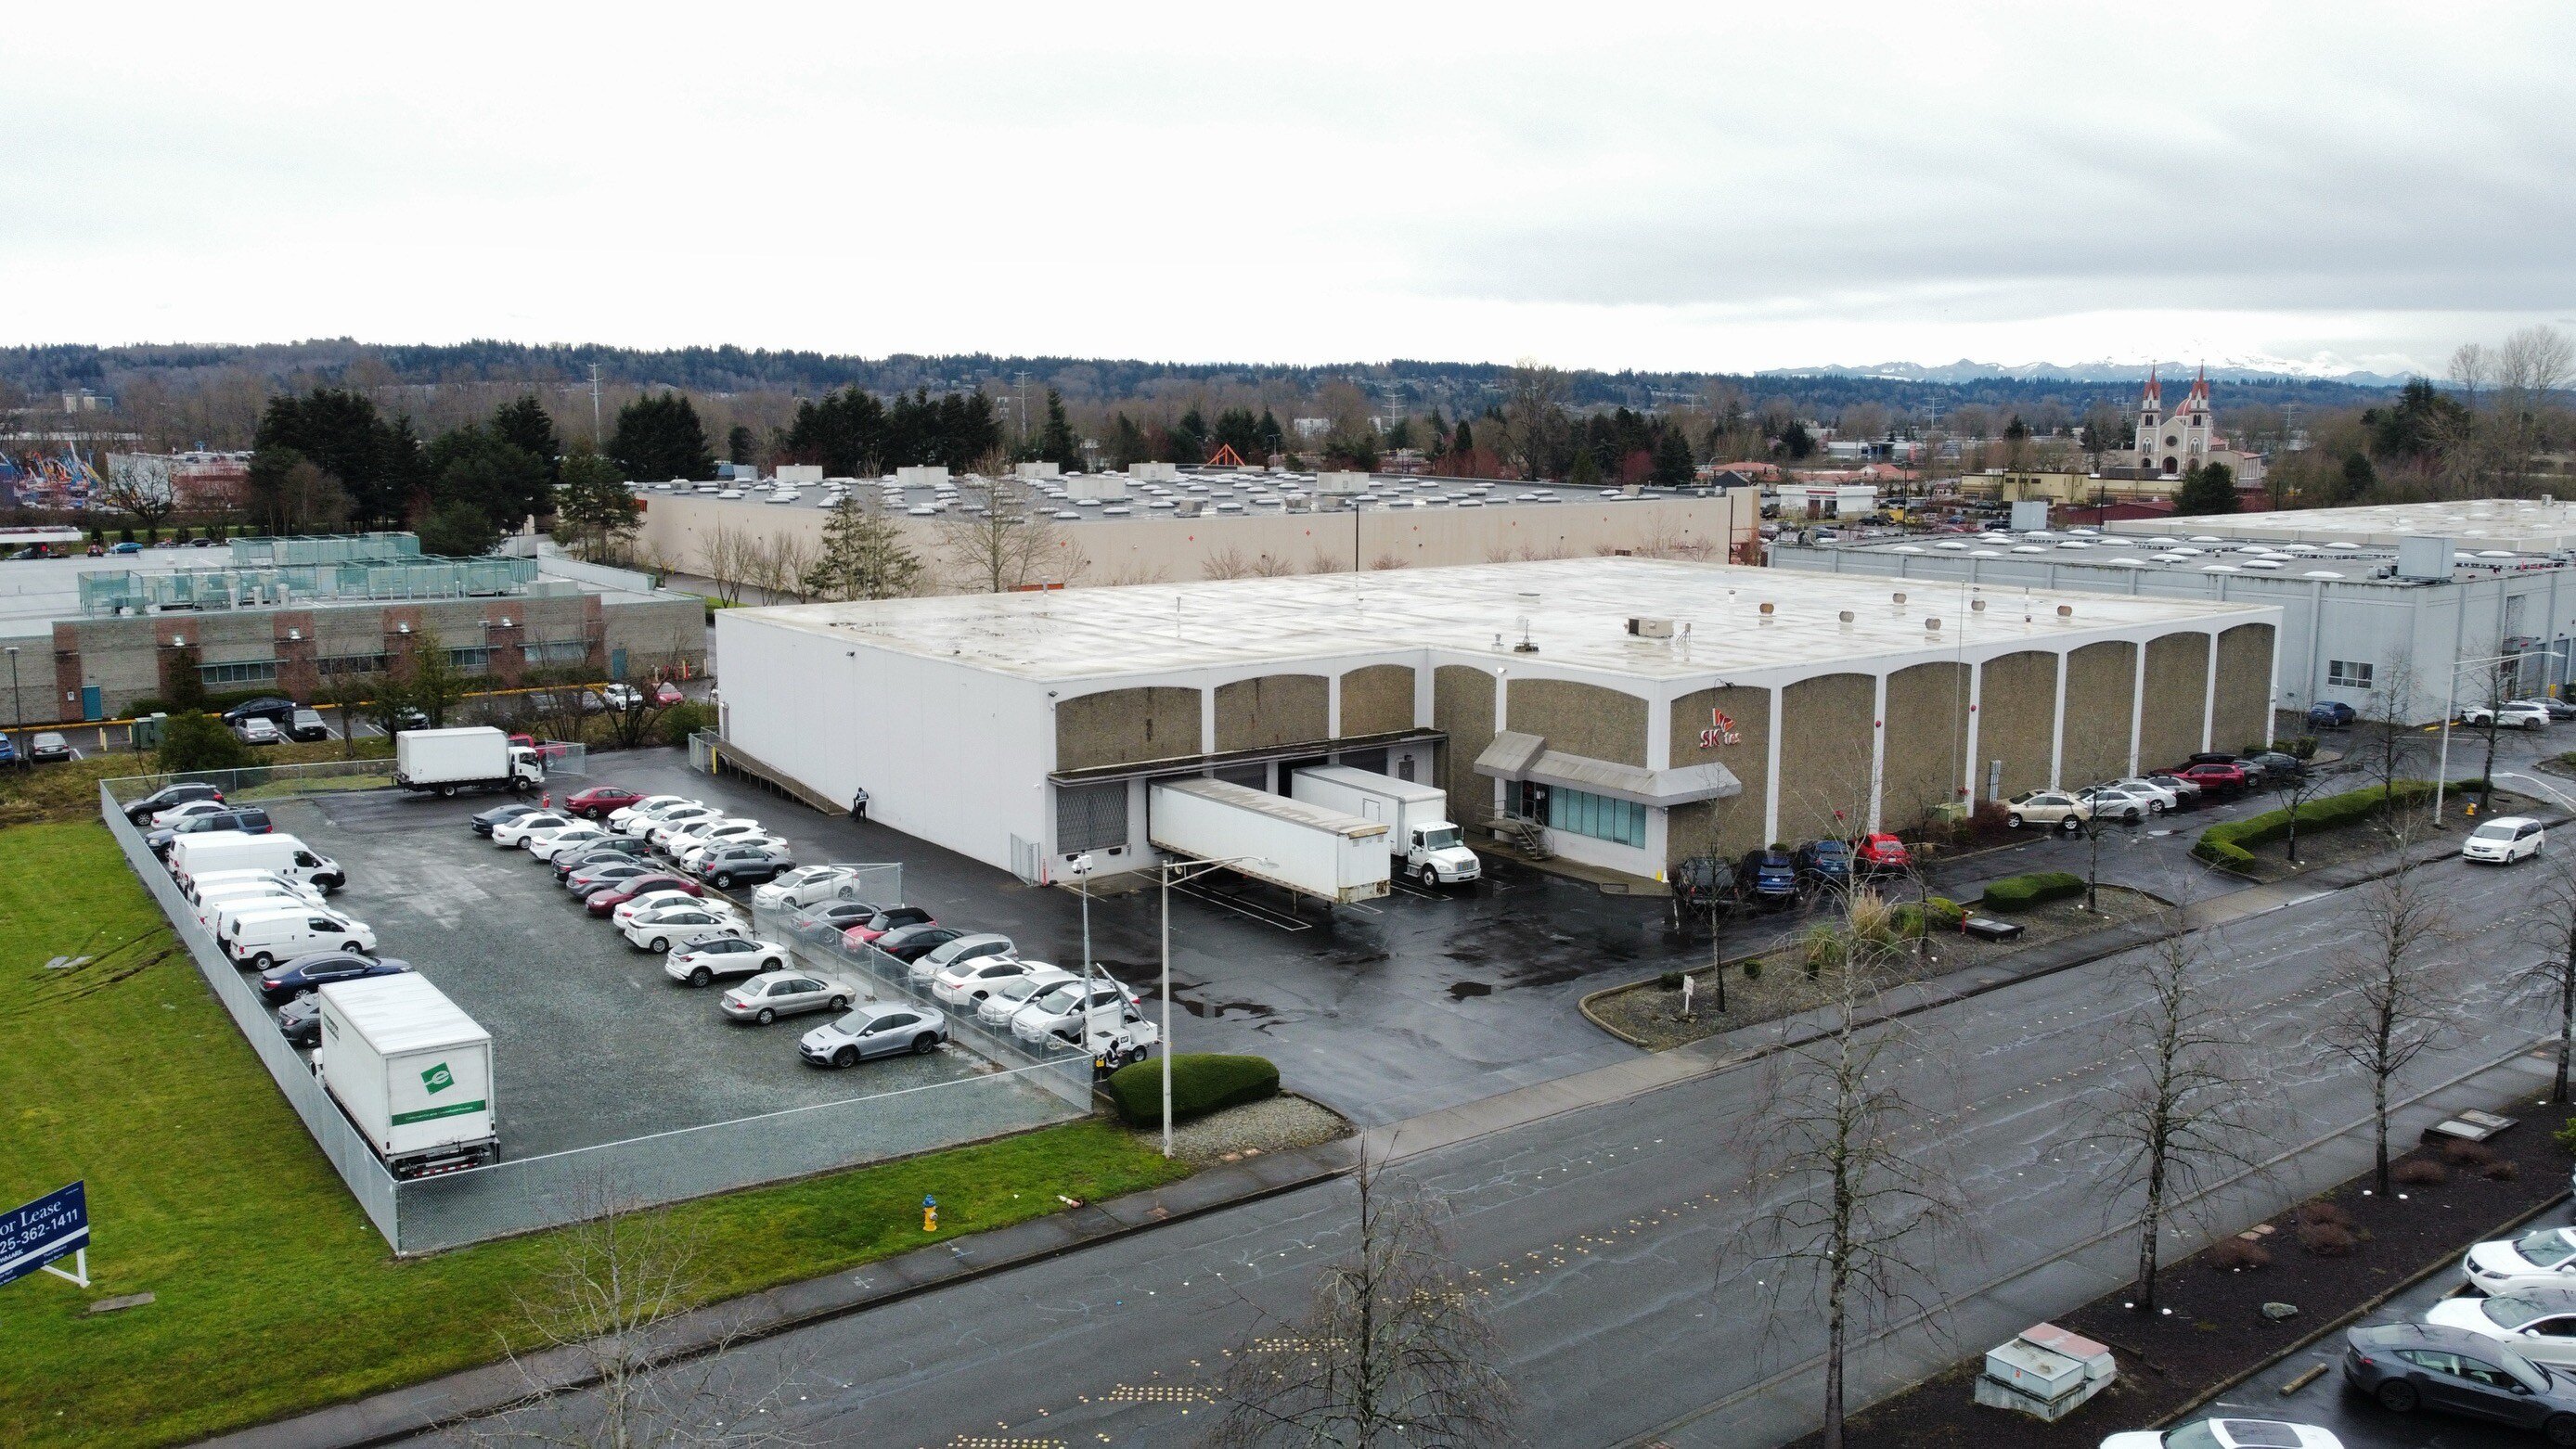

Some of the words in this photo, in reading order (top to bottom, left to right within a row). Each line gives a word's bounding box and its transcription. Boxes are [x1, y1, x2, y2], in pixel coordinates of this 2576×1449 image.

[1699, 728, 1720, 749] SK
[19, 1200, 62, 1228] Lease
[0, 1208, 78, 1254] 25-362-1411
